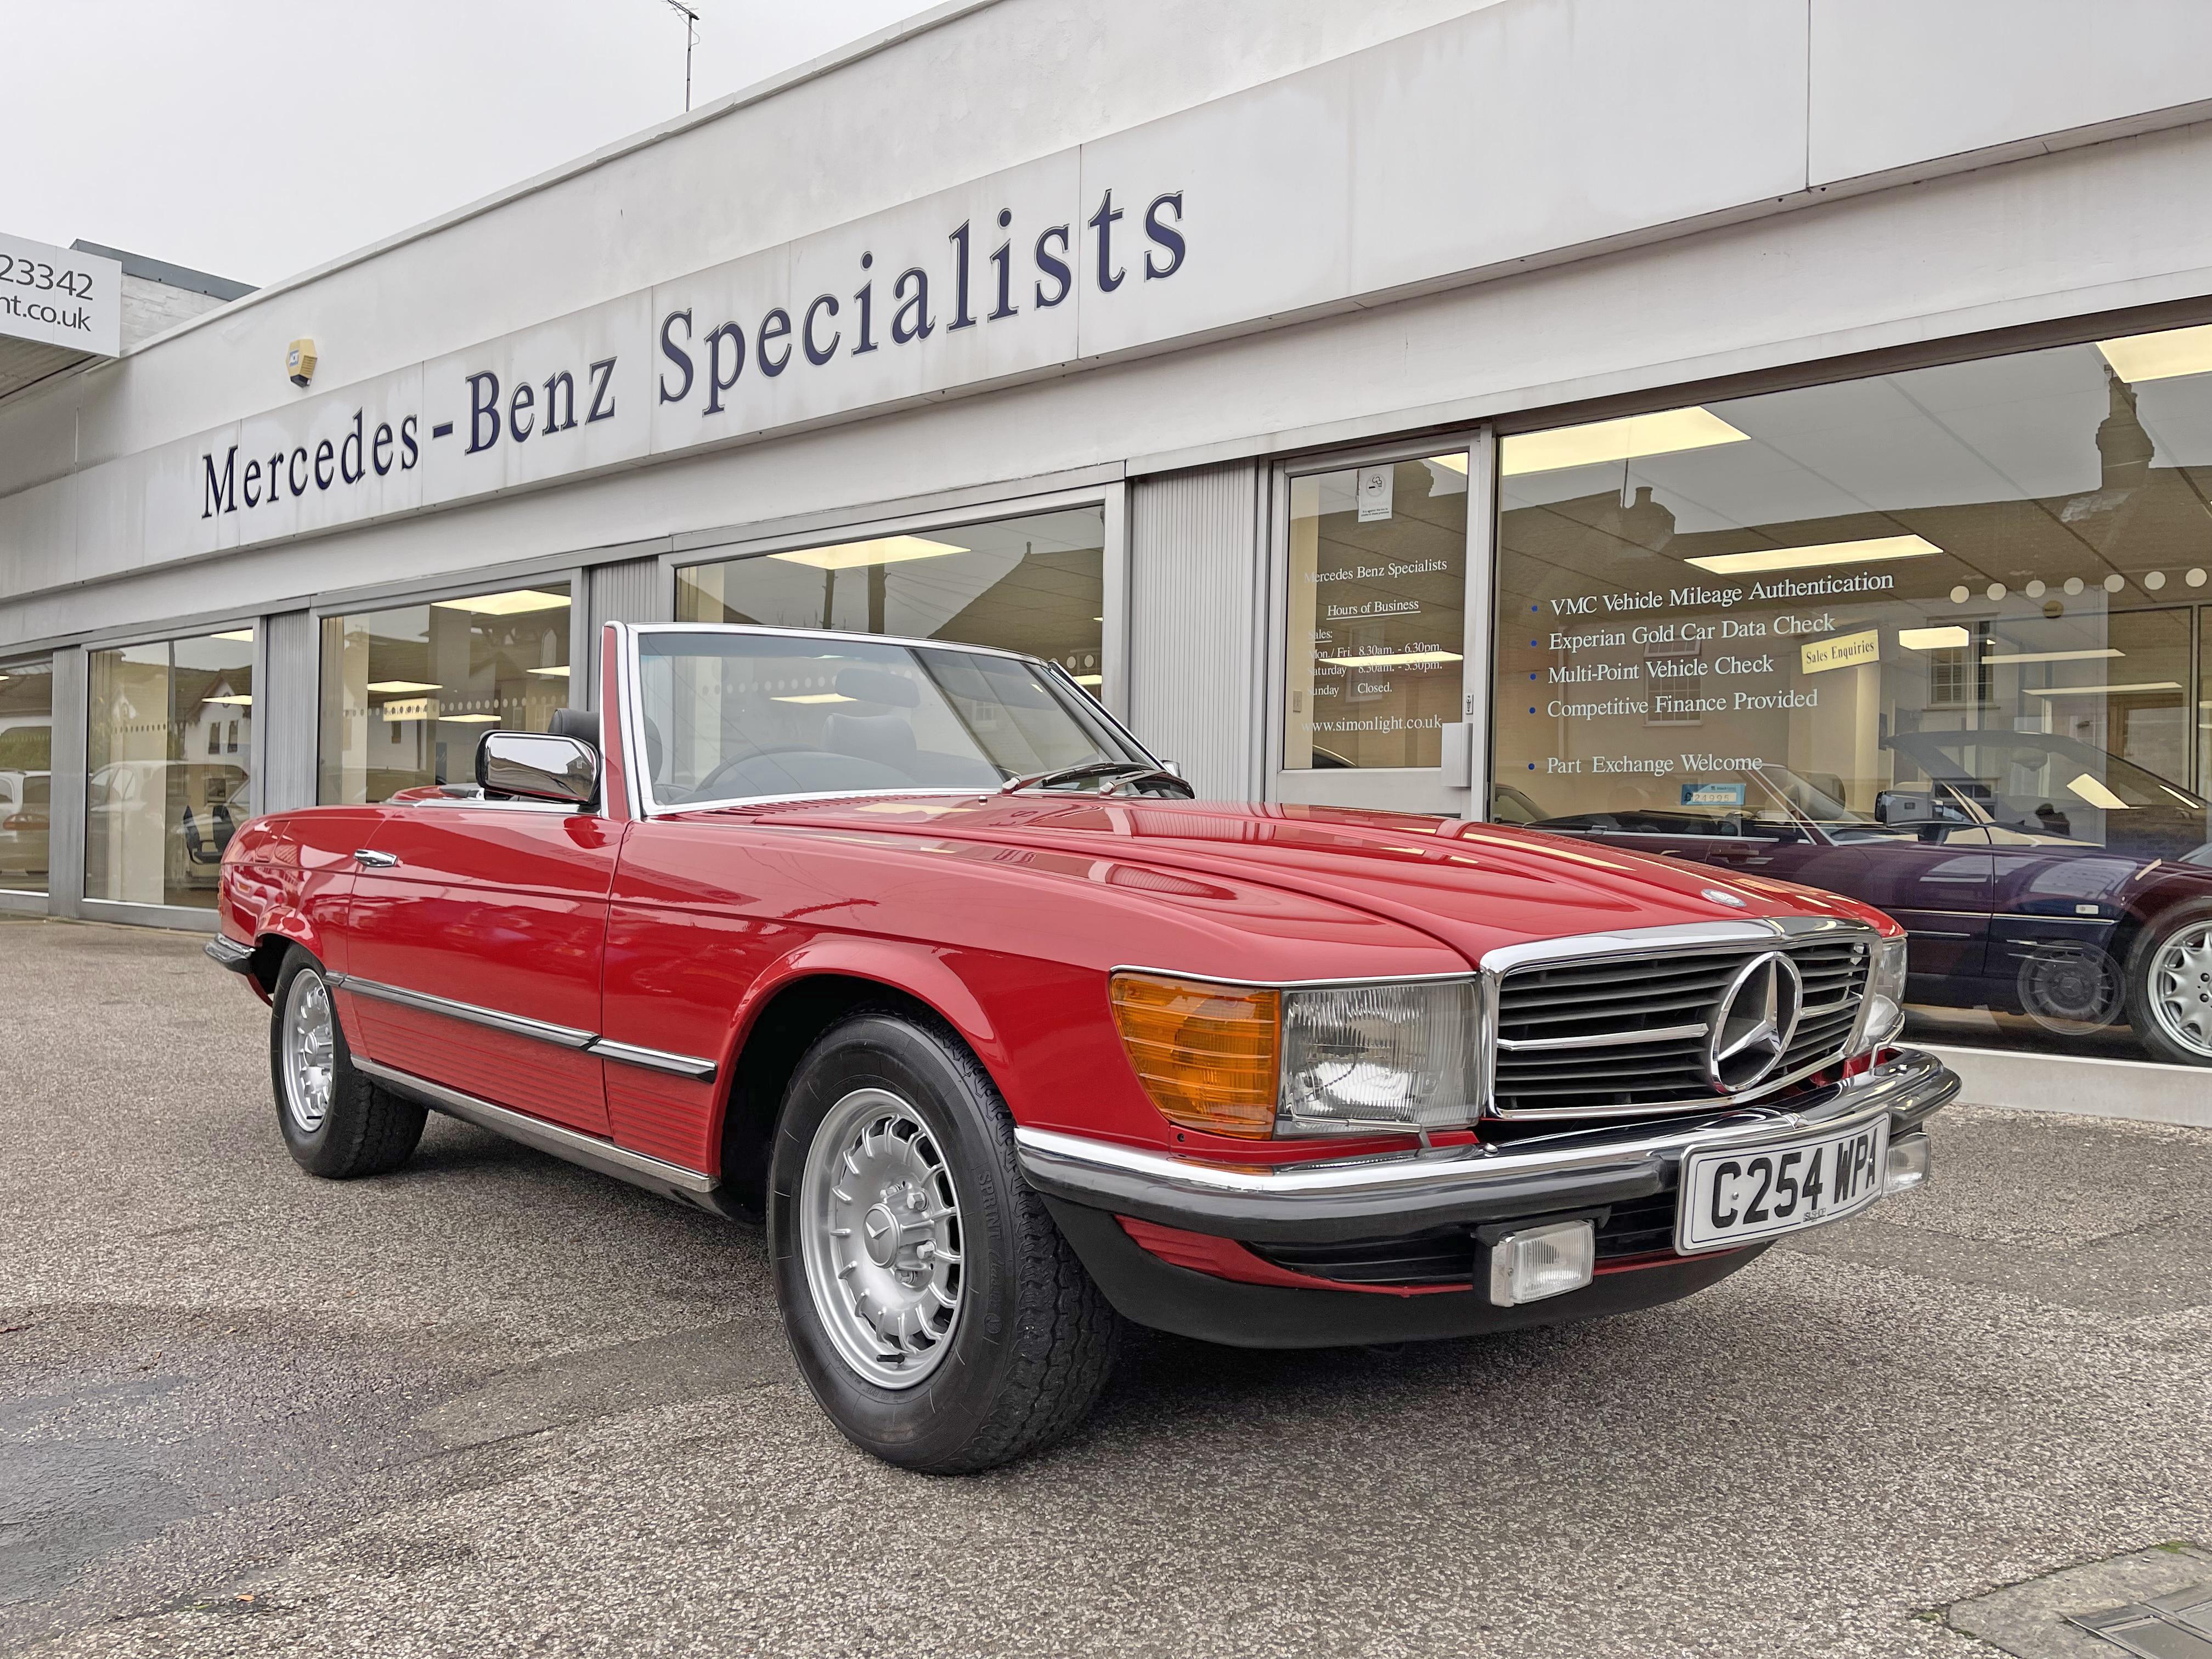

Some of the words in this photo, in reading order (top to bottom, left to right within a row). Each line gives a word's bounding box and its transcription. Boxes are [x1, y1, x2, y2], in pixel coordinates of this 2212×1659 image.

[0, 255, 93, 301] 23342
[201, 356, 618, 519] Mercedes-Benz
[659, 188, 1187, 417] Specialists
[289, 352, 299, 364] ADT
[1304, 568, 1353, 583] Mercedes
[1357, 566, 1385, 578] Benz
[1388, 559, 1447, 578] Specialists
[1550, 596, 1598, 616] VMC
[1602, 590, 1663, 612] Vehicle
[1669, 586, 1742, 607] Mileage
[1748, 572, 1894, 600] Authentication
[1328, 605, 1358, 616] Hours
[1361, 602, 1372, 613] of
[1374, 600, 1419, 613] Business
[1308, 629, 1333, 640] Sales:
[1549, 629, 1626, 653] Experian
[1632, 624, 1674, 644] Gold
[1680, 623, 1716, 641] Car
[1721, 619, 1767, 639] Data
[1773, 613, 1836, 635] Check
[1337, 646, 1352, 658] Fri.
[1358, 645, 1395, 657] 8.30am.
[1404, 641, 1442, 654] 6.30pm.
[1806, 650, 1828, 664] Sales
[1831, 640, 1874, 660] Enquiries
[1307, 664, 1347, 677] Saturday
[1548, 663, 1640, 684] Multi-Point
[1646, 658, 1708, 678] Vehicle
[1714, 654, 1774, 675] Check
[1307, 685, 1339, 697] Sunday
[1357, 682, 1392, 694] Closed.
[1547, 697, 1649, 720] Competitive
[1655, 695, 1727, 713] Finance
[1733, 689, 1819, 710] Provided
[1301, 714, 1443, 734] www.simonlight.co.uk
[1547, 757, 1582, 774] Part
[1592, 755, 1674, 777] Exchange
[1680, 753, 1763, 771] Welcome
[1711, 1147, 1823, 1228] C254
[1833, 1127, 1878, 1205] WPA
[976, 1170, 1003, 1240] SPRINT
